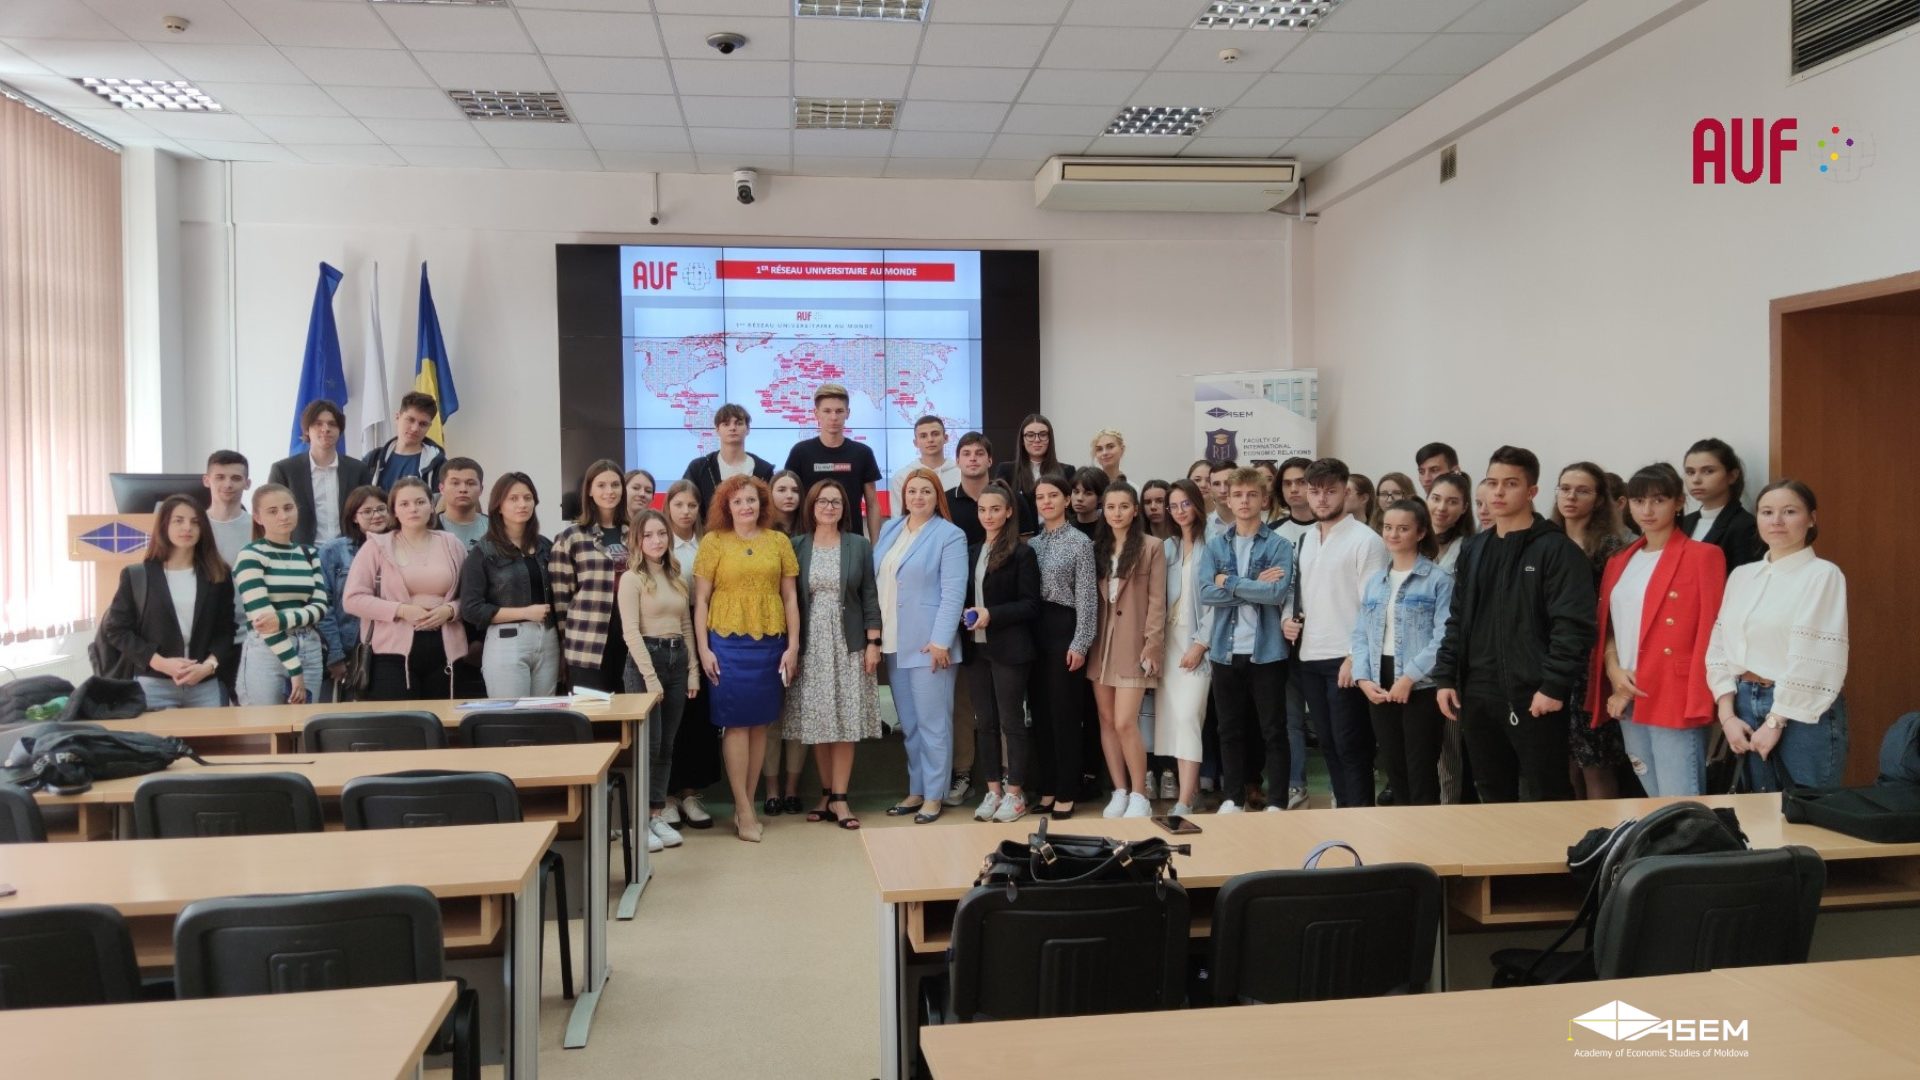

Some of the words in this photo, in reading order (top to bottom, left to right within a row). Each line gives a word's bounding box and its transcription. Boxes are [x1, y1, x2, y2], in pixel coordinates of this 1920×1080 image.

[633, 261, 678, 290] AUF
[770, 263, 803, 274] RÉSEAU
[805, 266, 868, 275] UNIVERSITAIRE
[870, 267, 882, 275] AU
[884, 267, 917, 276] MONDE
[796, 311, 812, 321] AUF
